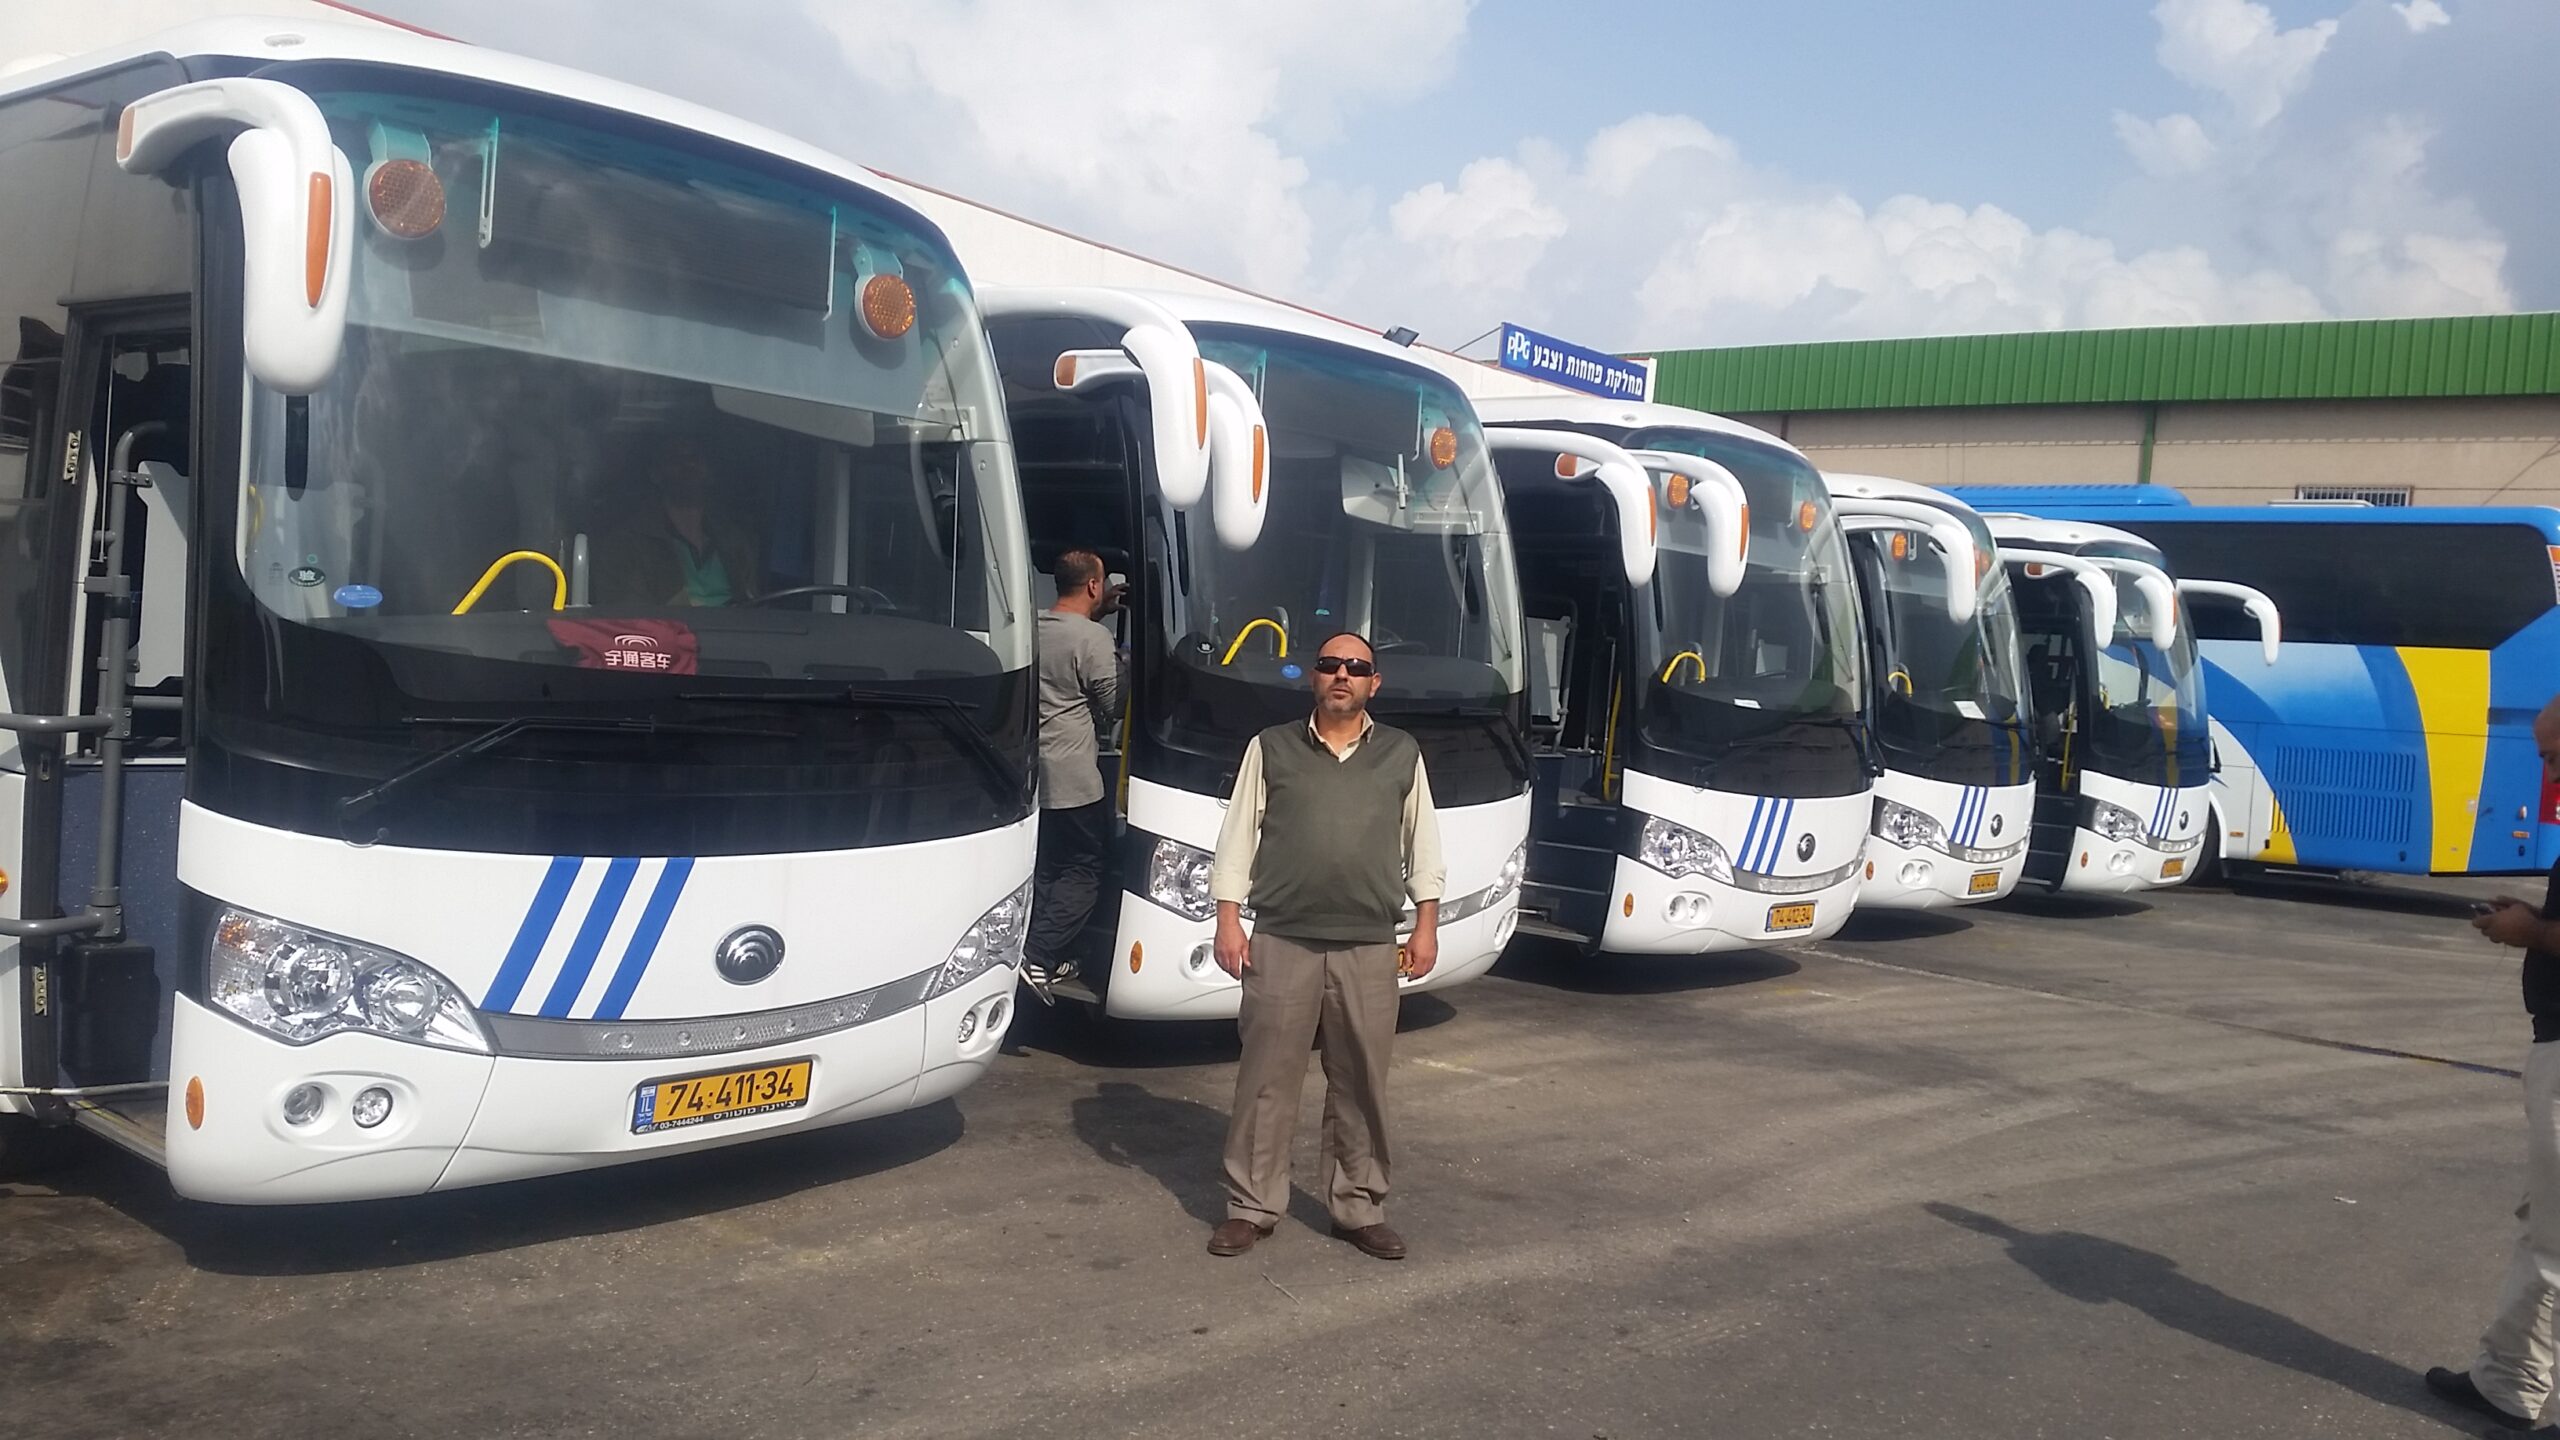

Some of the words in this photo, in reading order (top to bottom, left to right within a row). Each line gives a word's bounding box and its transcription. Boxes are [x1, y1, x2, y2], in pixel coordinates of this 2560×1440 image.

[1507, 331, 1531, 361] PPG
[1533, 344, 1563, 373] וצבע
[1566, 355, 1603, 384] פחחות
[1605, 367, 1644, 396] מחלקת
[604, 650, 672, 669] 宇通客车
[660, 1116, 704, 1128] 03-7444244
[713, 1107, 757, 1120] מוטורס
